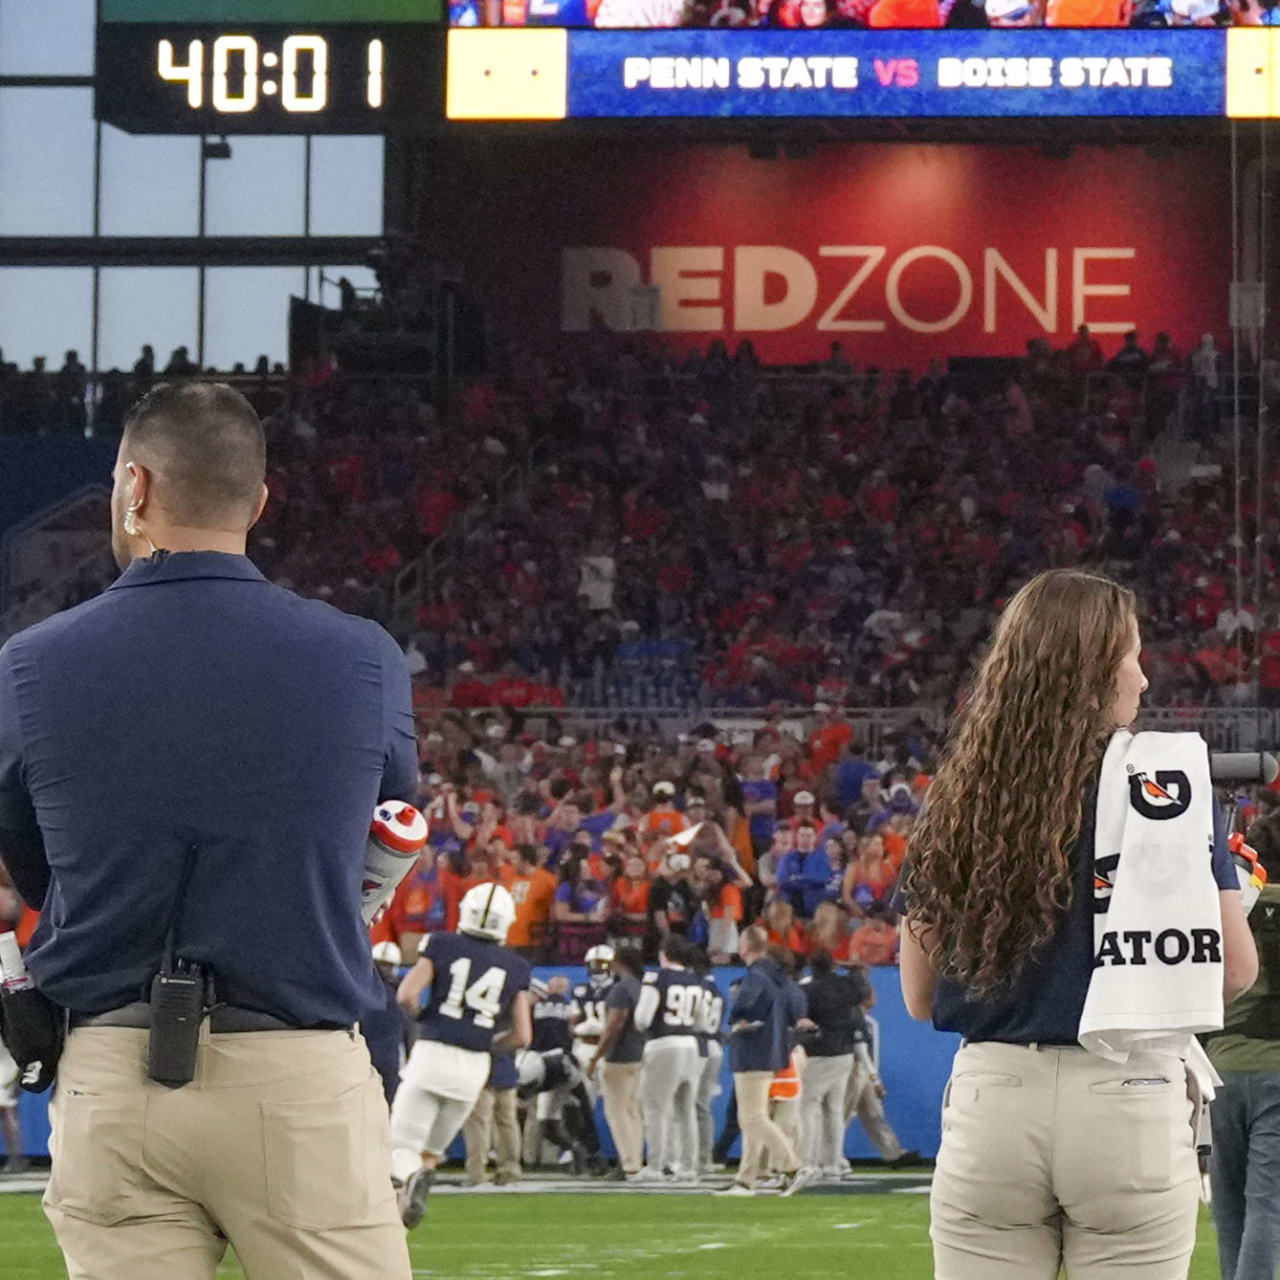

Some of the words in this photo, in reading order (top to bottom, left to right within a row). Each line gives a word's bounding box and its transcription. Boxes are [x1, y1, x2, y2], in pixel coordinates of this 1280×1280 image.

[623, 57, 729, 88] PENN
[737, 57, 858, 88] STATE
[873, 58, 920, 87] VS
[938, 57, 1051, 87] BOISE
[1059, 57, 1173, 87] STATE
[438, 956, 507, 1030] 14
[663, 984, 703, 1028] 90
